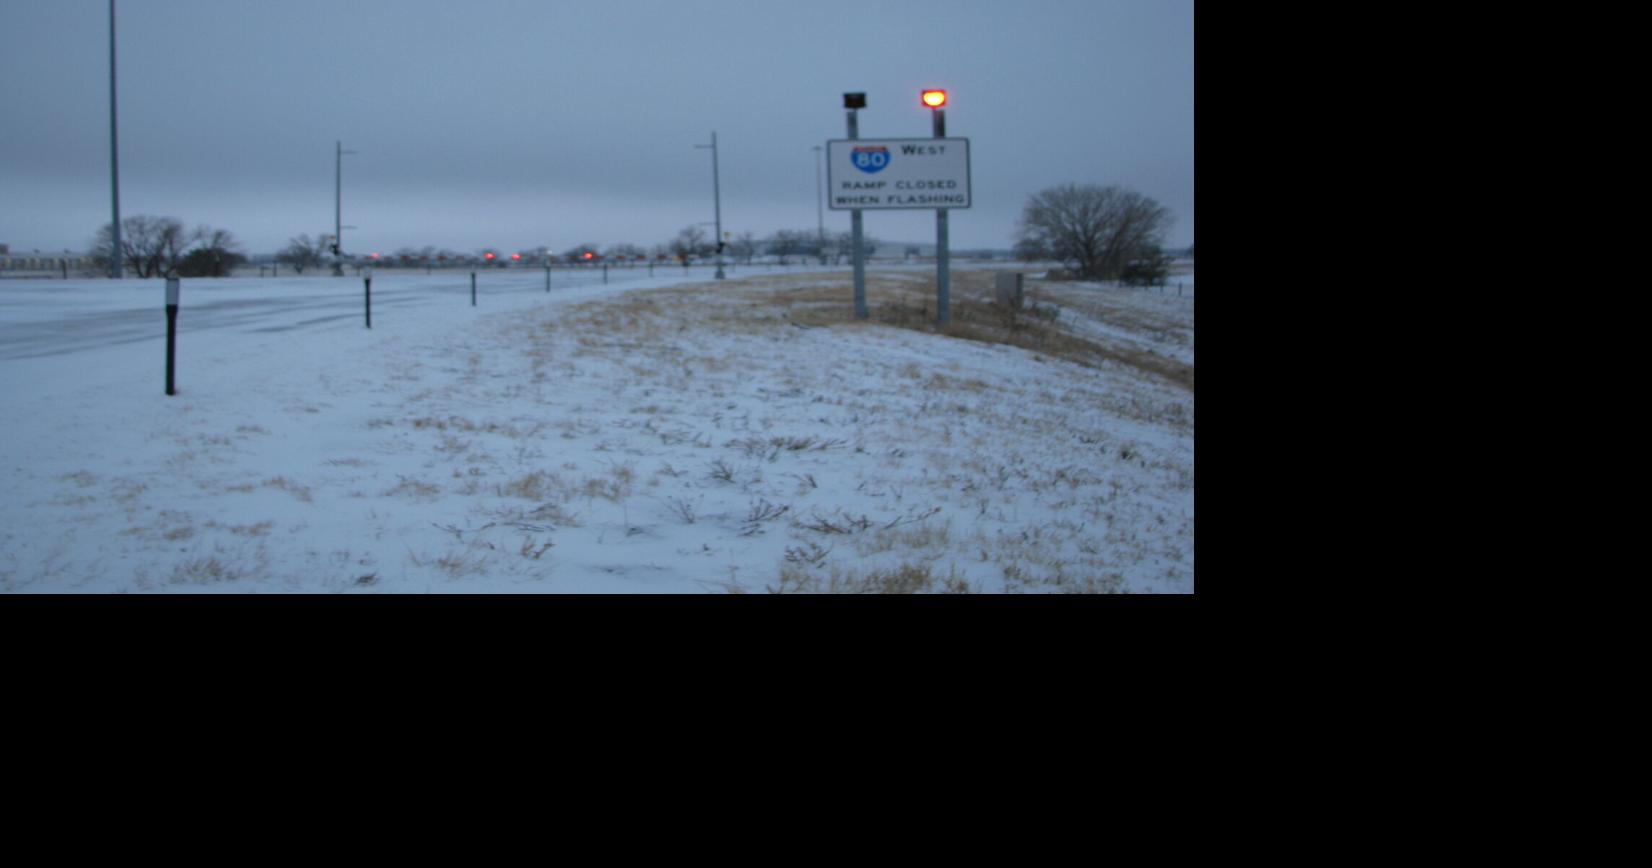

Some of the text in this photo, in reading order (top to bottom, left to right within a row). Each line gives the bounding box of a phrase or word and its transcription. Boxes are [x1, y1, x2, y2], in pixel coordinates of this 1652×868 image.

[901, 144, 947, 155] WEST
[856, 152, 886, 168] 80
[842, 180, 957, 190] RAMP CLOSED
[836, 194, 965, 204] WHEN FLASHING
